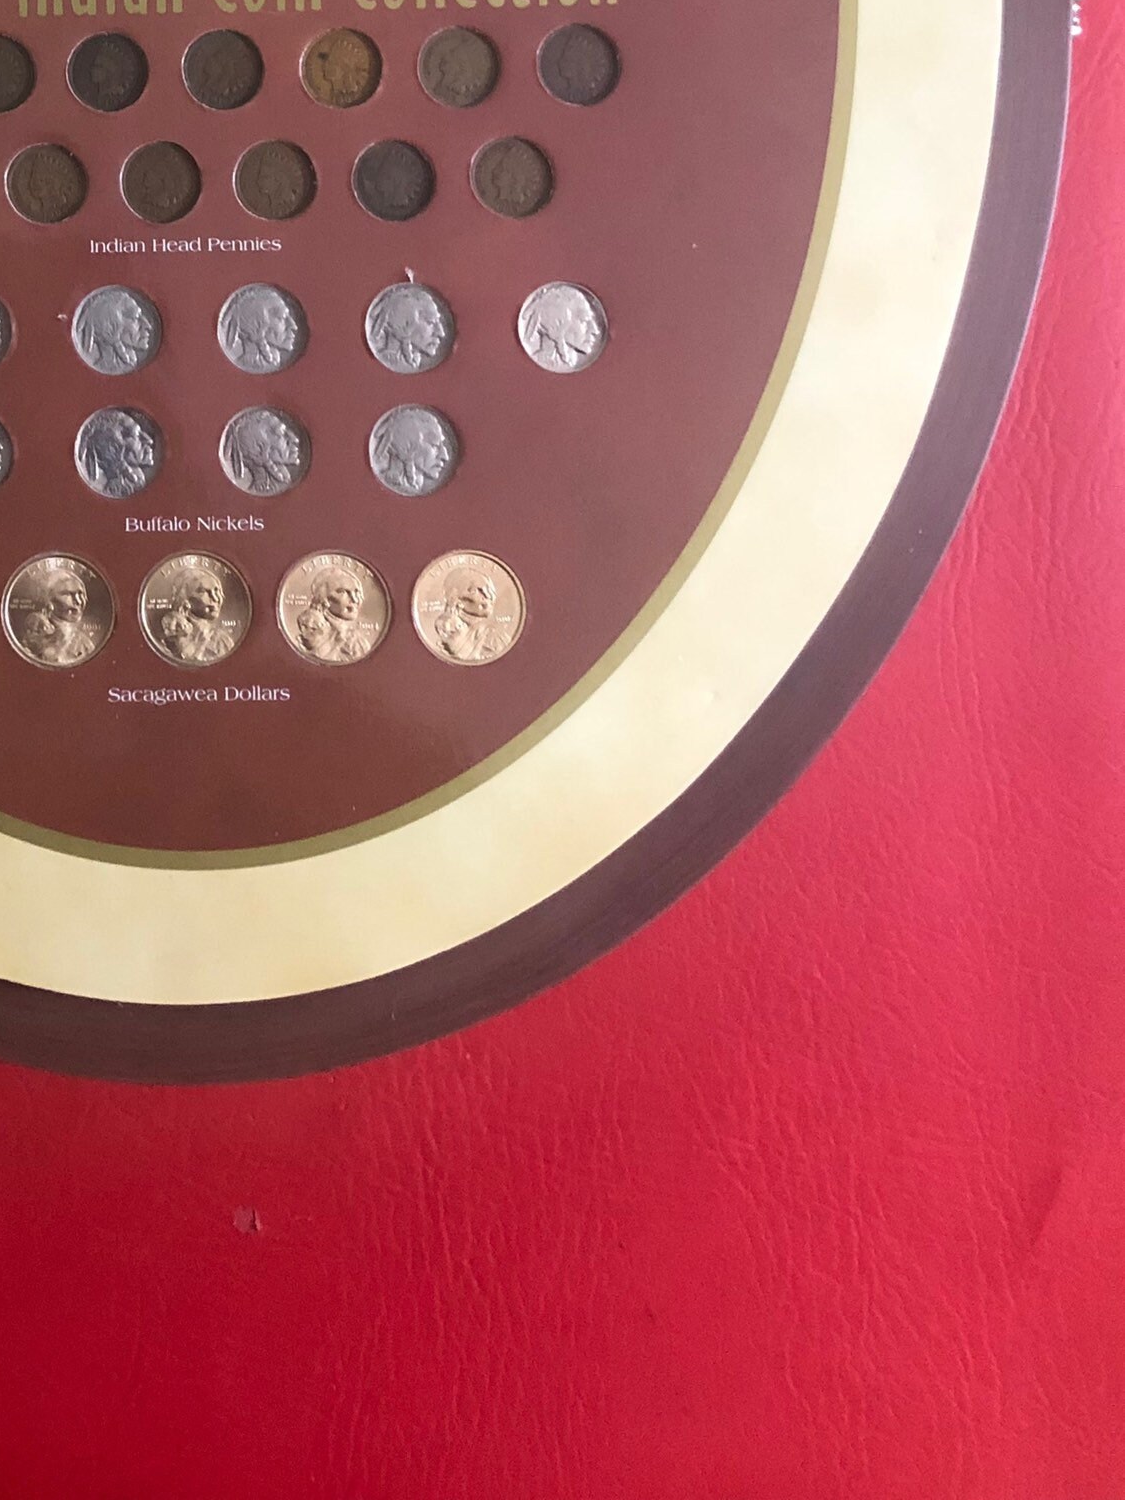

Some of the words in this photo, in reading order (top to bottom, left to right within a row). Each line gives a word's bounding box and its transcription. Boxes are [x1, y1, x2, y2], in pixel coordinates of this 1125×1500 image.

[90, 238, 145, 253] Indian
[153, 237, 201, 252] Head
[208, 236, 282, 251] Pennies
[125, 516, 191, 532] Buffalo
[197, 515, 264, 531] Nickels
[108, 687, 218, 705] Sacagawea
[225, 686, 290, 701] Dollars
